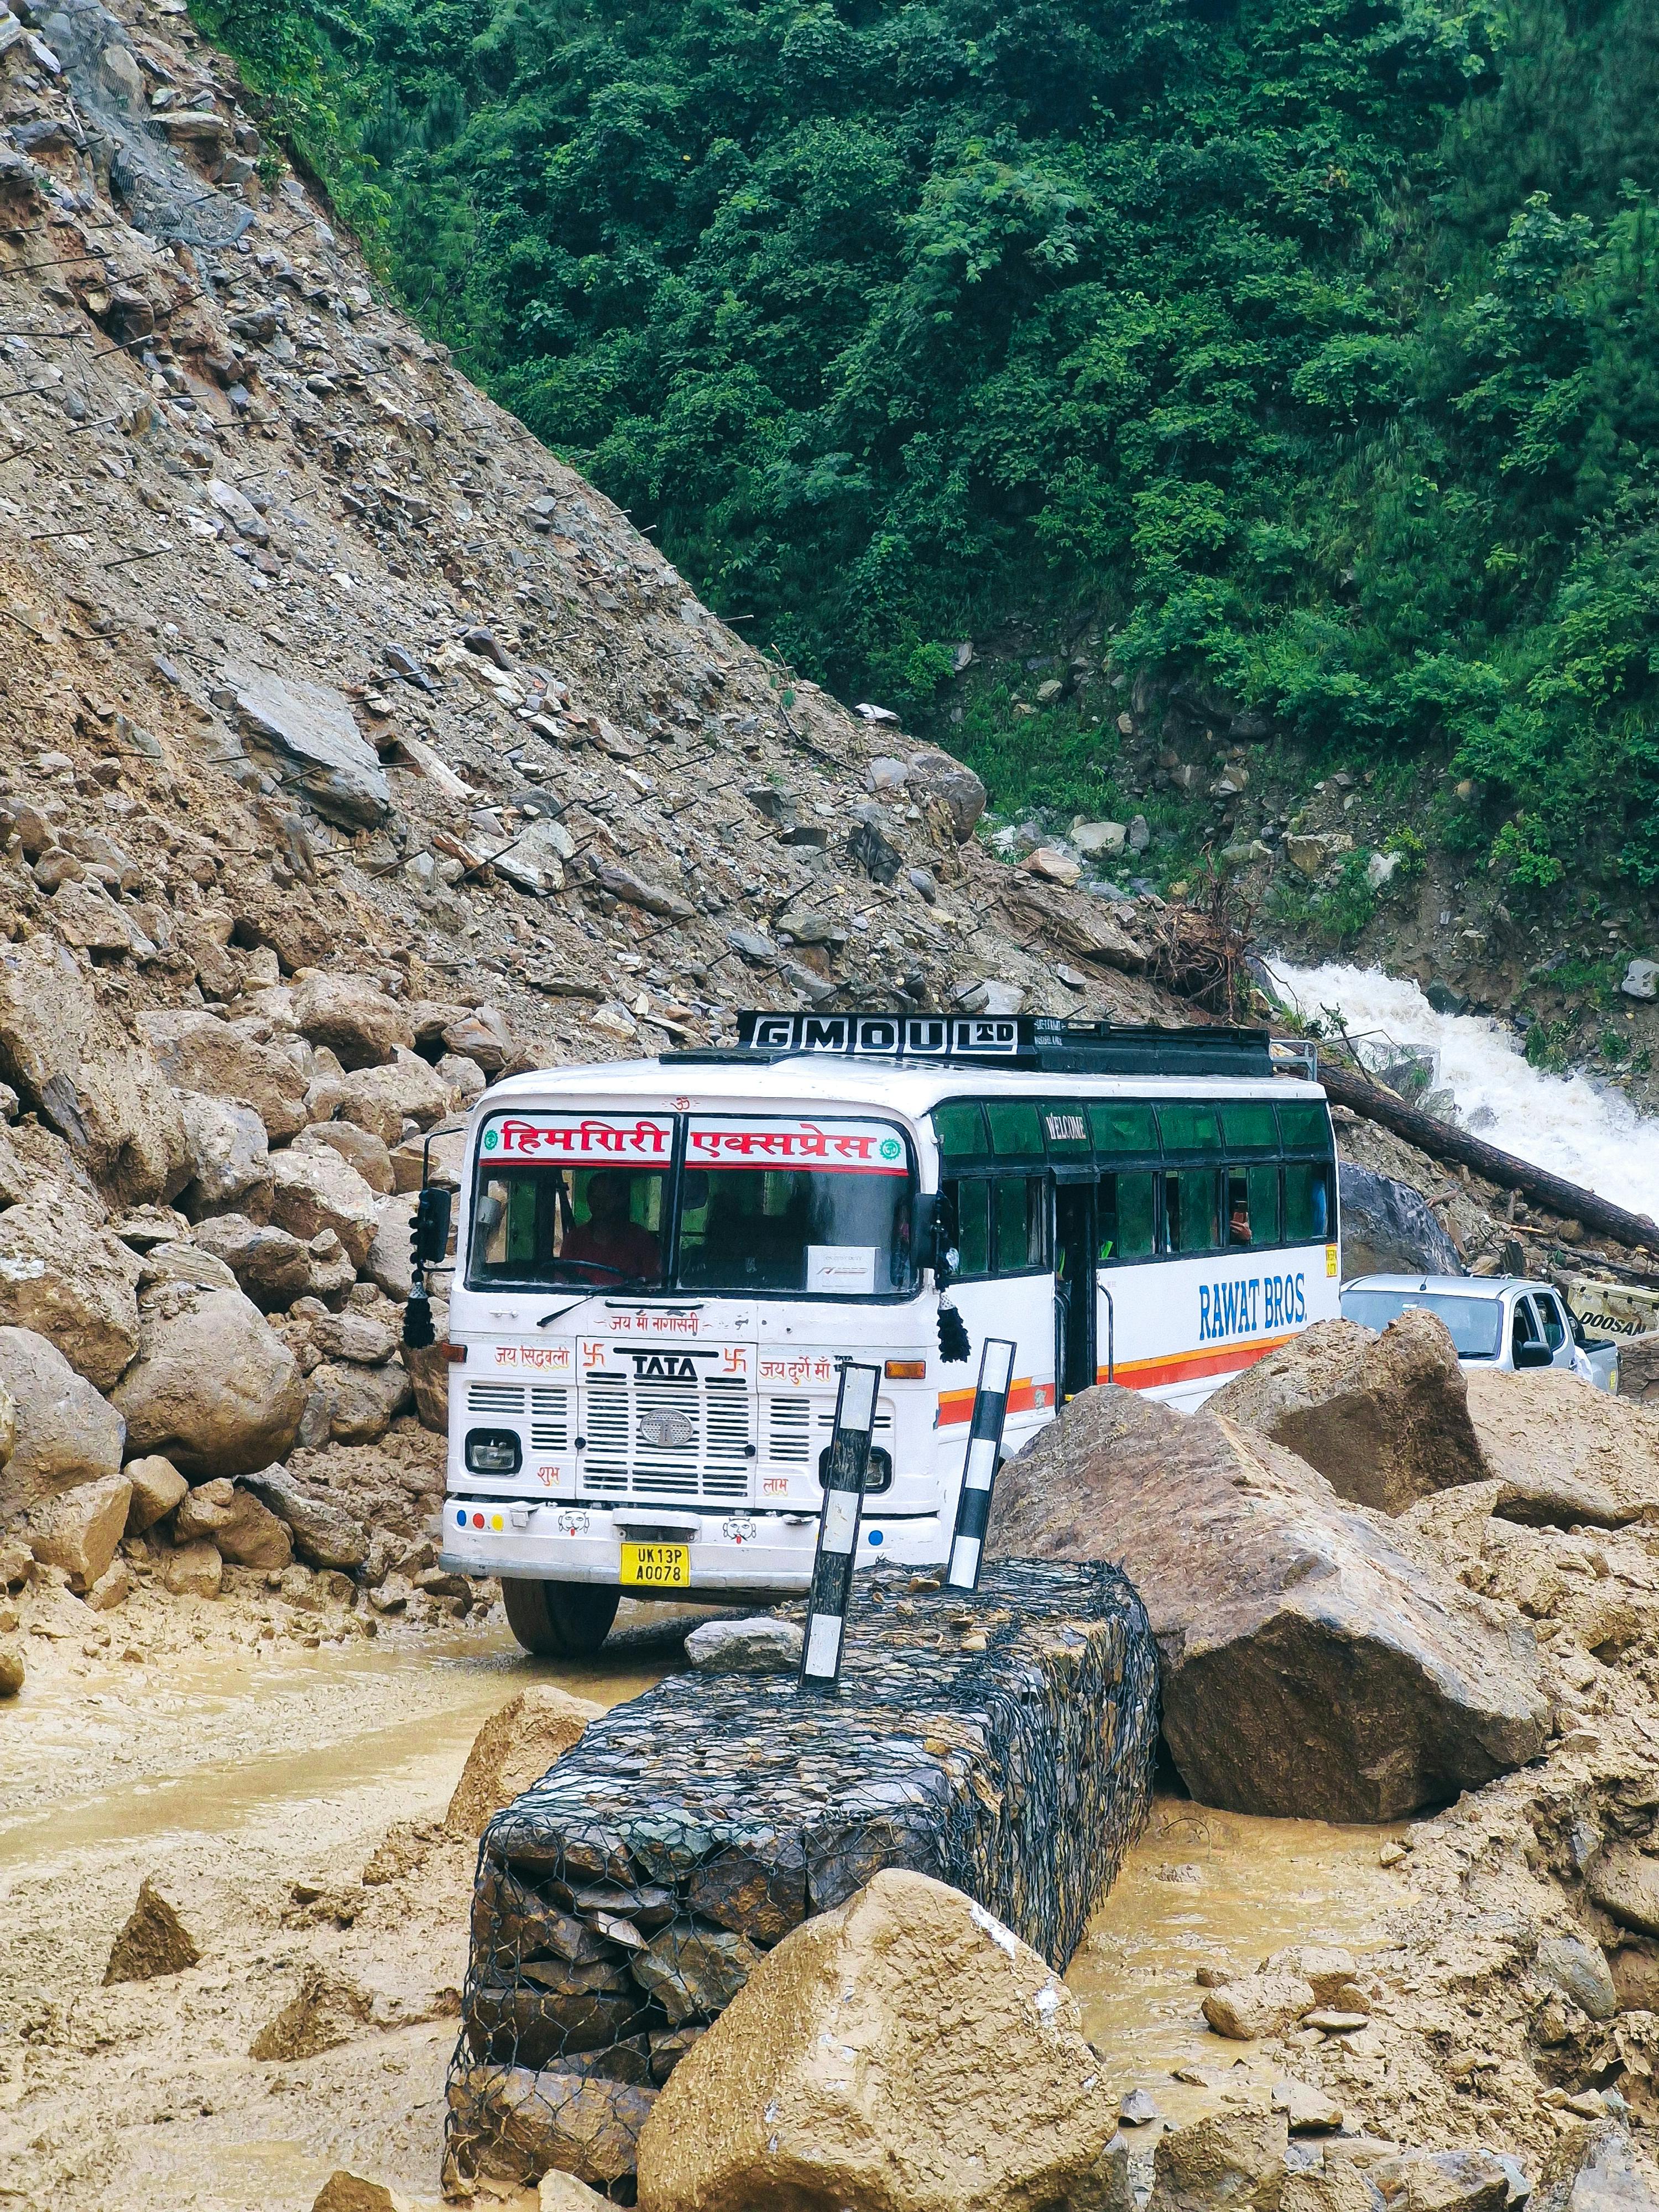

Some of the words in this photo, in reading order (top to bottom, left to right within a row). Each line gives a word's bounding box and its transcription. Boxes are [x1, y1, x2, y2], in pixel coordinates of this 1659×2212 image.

[1045, 1113, 1086, 1140] WELCOME
[690, 1123, 878, 1159] एक्सप्रेस
[1199, 1279, 1260, 1340] RAWAT
[1264, 1272, 1307, 1328] BROS.
[609, 1316, 632, 1331] जय
[1578, 1311, 1647, 1336] DOOSAN
[495, 1347, 518, 1366] जय
[632, 1356, 697, 1376] TATA
[759, 1361, 785, 1379] जय
[787, 1355, 812, 1384] दुर्गे
[813, 1355, 831, 1381] माँ
[536, 1467, 560, 1486] शुभ
[763, 1478, 789, 1494] लाभ
[638, 1548, 682, 1563] UK13P
[637, 1566, 681, 1581] A0078
